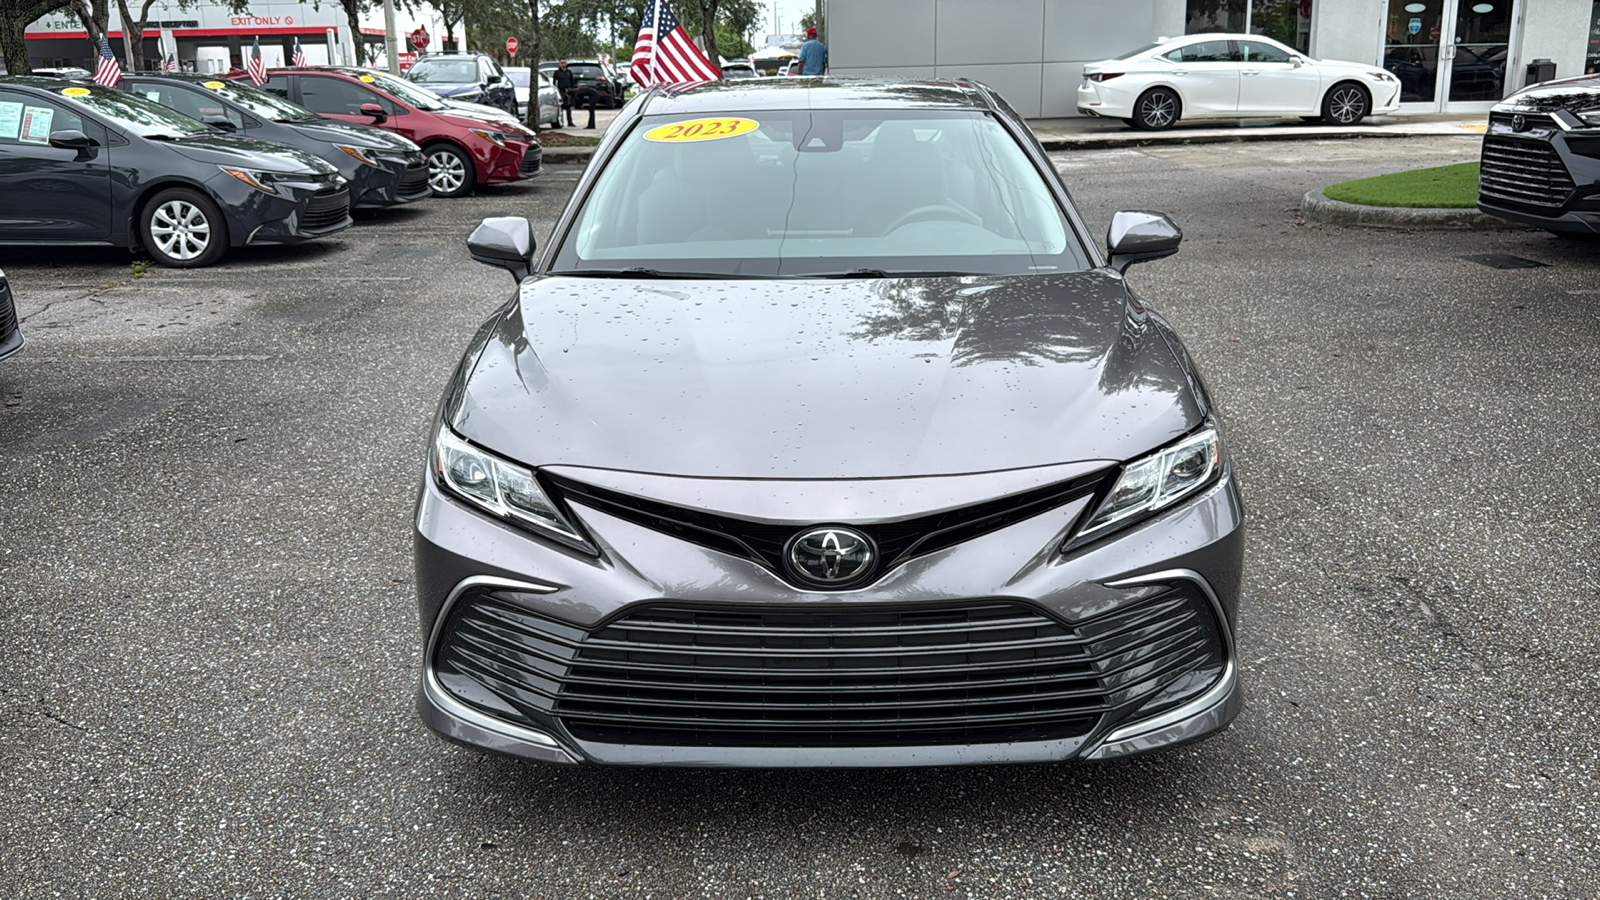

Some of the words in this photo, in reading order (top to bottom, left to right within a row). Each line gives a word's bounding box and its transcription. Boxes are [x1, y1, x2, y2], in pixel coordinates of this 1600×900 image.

[54, 20, 84, 30] ENTE
[231, 17, 251, 26] EXIT
[254, 16, 281, 26] ONLY
[662, 120, 741, 139] 2023
